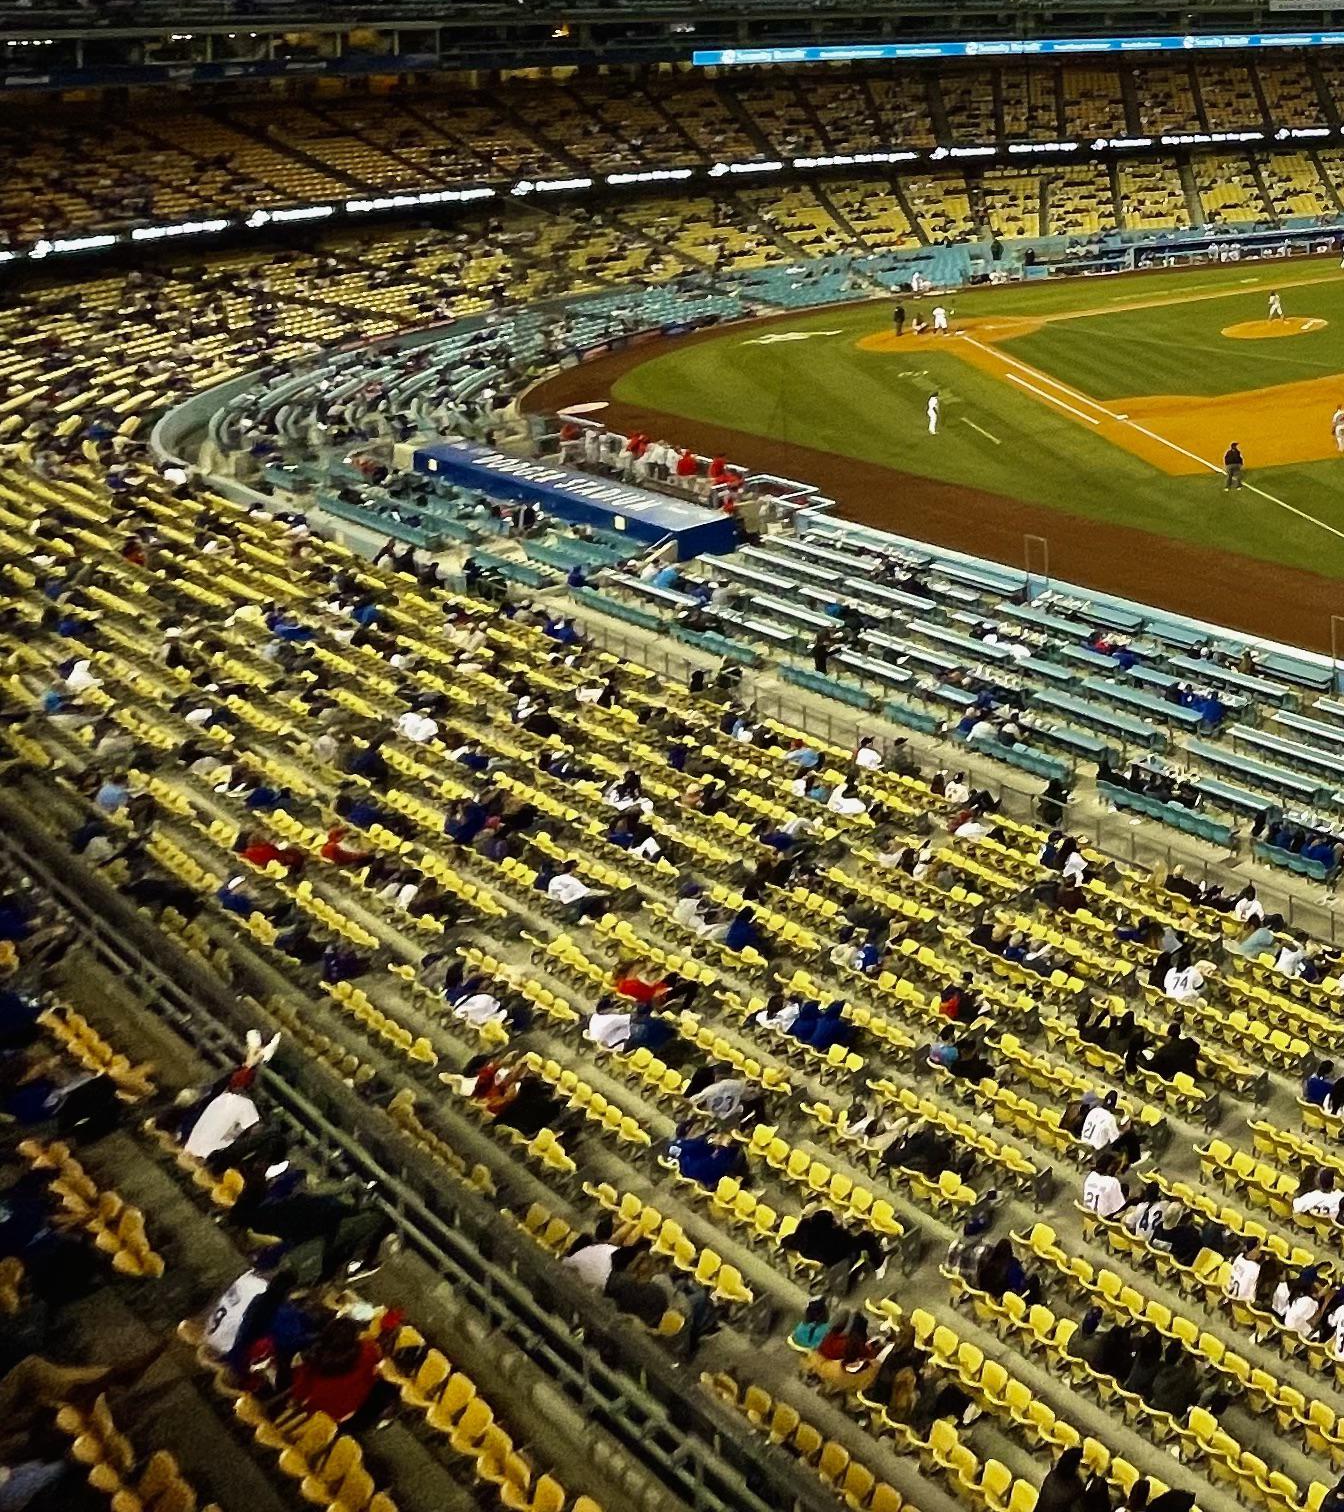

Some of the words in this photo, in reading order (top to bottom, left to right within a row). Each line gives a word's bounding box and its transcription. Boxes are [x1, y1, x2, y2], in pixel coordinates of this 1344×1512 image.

[472, 453, 567, 484] DODGER
[554, 478, 662, 512] STADIUM
[1173, 975, 1189, 990] 74
[1083, 1120, 1096, 1139] 21
[1085, 1191, 1099, 1207] 21
[1139, 1210, 1163, 1232] 42
